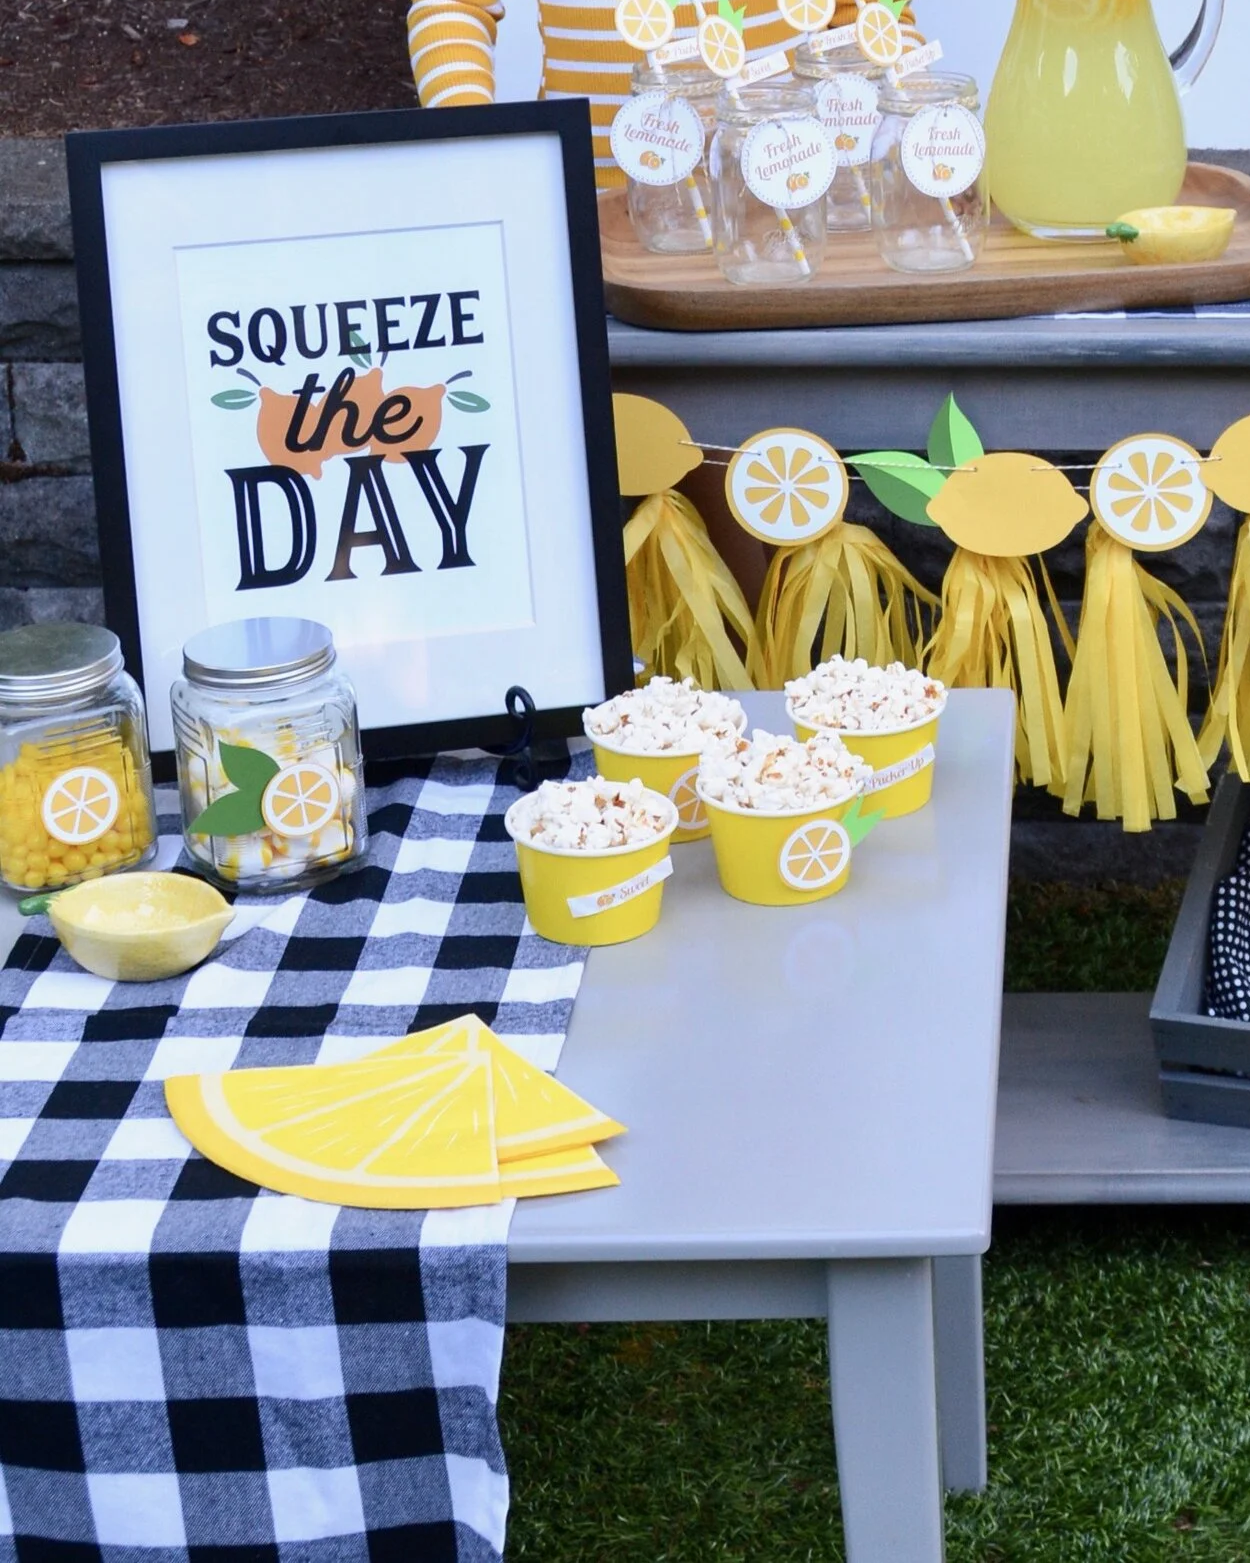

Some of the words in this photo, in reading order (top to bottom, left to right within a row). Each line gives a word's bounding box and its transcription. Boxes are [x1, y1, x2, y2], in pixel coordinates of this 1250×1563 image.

[826, 97, 863, 113] Fresh
[624, 123, 693, 152] Lemonade
[643, 113, 681, 135] Fresh
[928, 126, 961, 141] Fresh
[763, 134, 802, 159] Fresh
[912, 141, 976, 161] Lemonade
[755, 141, 824, 181] Lemonade
[206, 289, 485, 368] SQUEEZE
[284, 367, 424, 454] the
[223, 443, 491, 592] DAY
